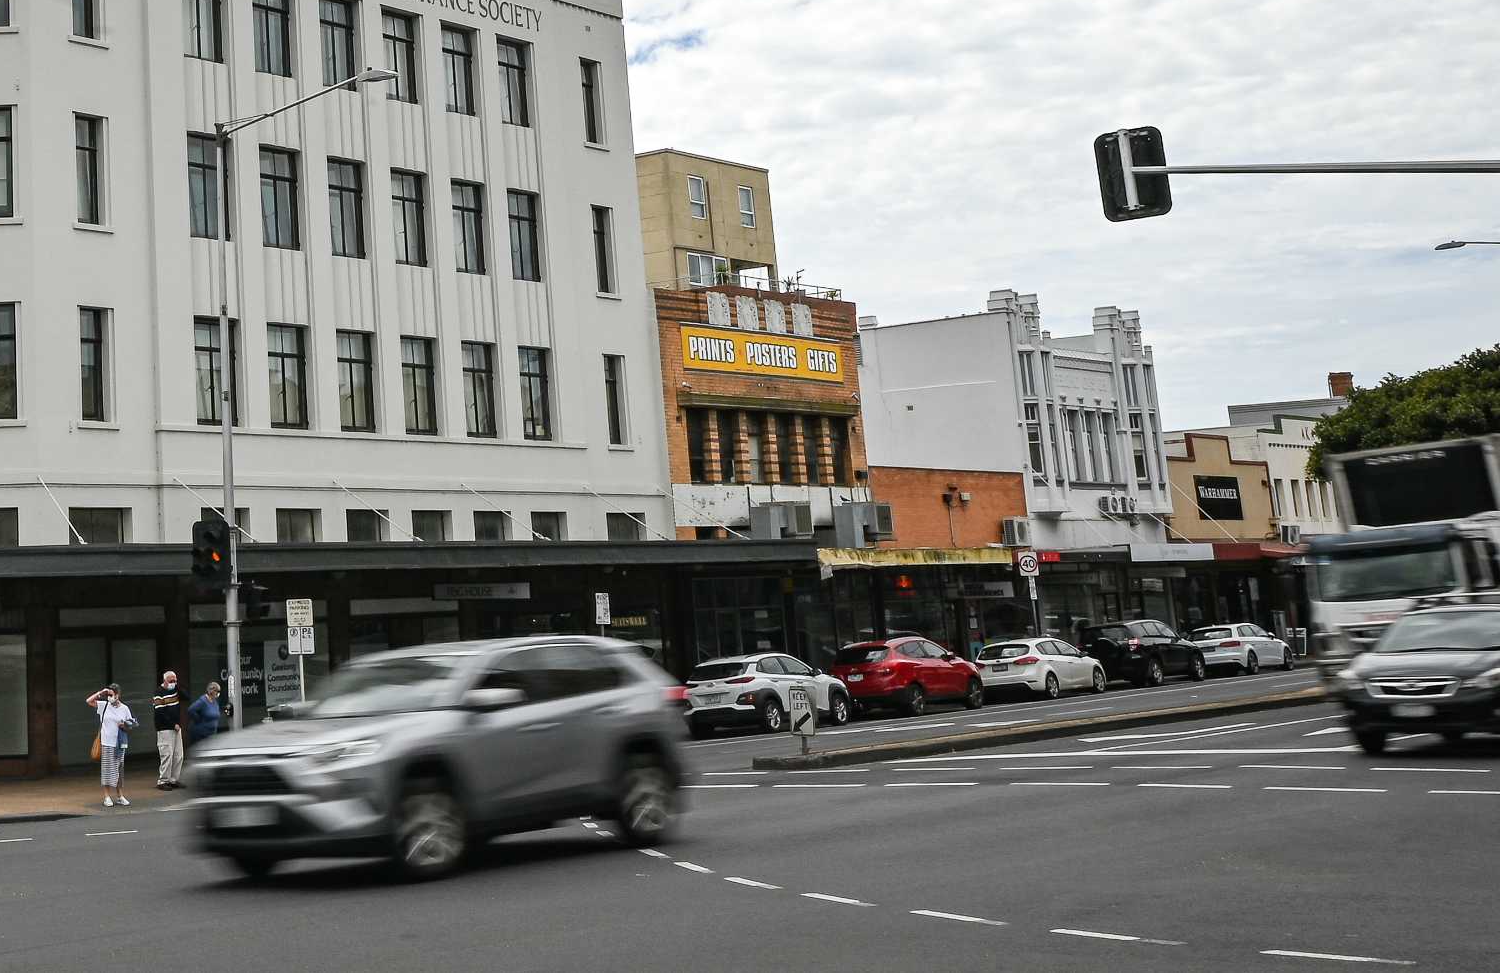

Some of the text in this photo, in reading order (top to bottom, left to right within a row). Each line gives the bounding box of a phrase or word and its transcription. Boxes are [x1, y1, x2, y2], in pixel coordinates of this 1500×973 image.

[688, 335, 838, 373] PRINTS POSTERS GIFTS
[1197, 486, 1238, 499] WARHAMMER
[1022, 560, 1036, 569] 40
